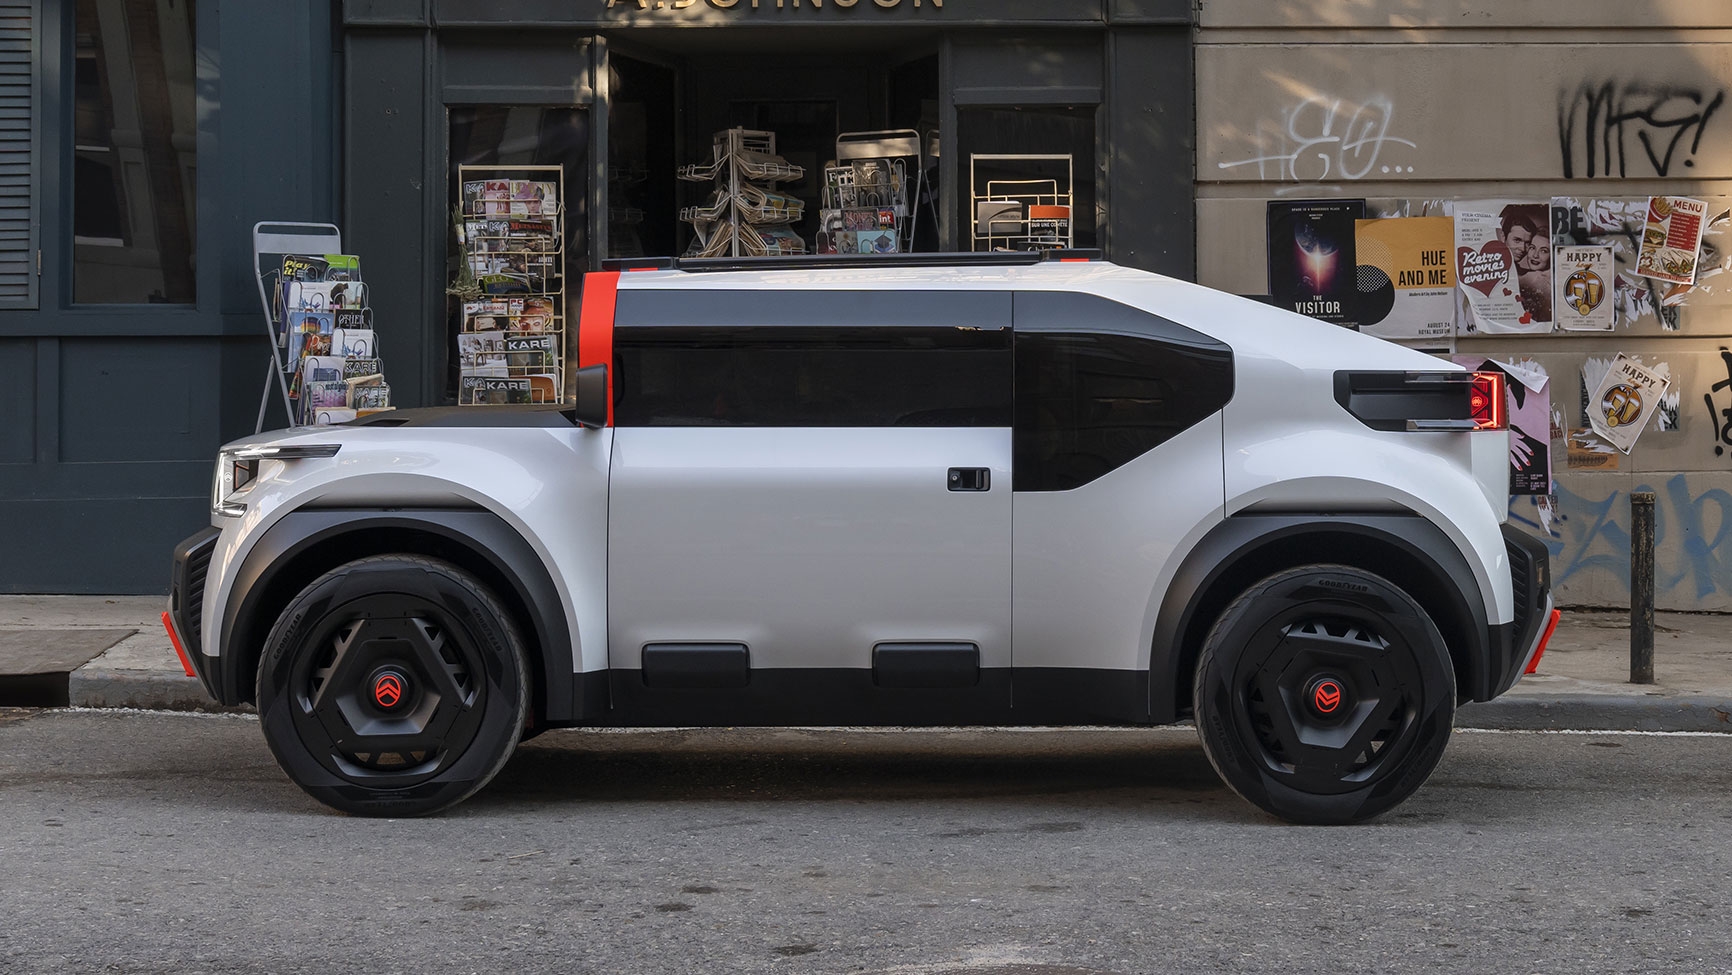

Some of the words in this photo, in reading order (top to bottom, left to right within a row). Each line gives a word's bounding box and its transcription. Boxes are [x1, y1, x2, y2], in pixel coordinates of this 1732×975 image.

[465, 183, 485, 193] KA
[487, 182, 508, 192] KA
[1673, 200, 1703, 212] MENU
[489, 222, 509, 232] KA
[1422, 250, 1446, 266] HUE
[1462, 251, 1502, 266] Retro
[1566, 252, 1602, 262] HAPPY
[1463, 260, 1505, 275] movies
[1398, 270, 1424, 286] AND
[1428, 270, 1447, 285] ME
[1464, 270, 1508, 284] evening
[1296, 302, 1340, 314] VISITOR
[508, 340, 550, 350] KARE
[1622, 364, 1656, 388] HAPPY
[464, 377, 486, 388] KA
[486, 382, 528, 390] KARE
[1318, 579, 1368, 592] GOODYEAR
[274, 613, 302, 660] GOODYEAR
